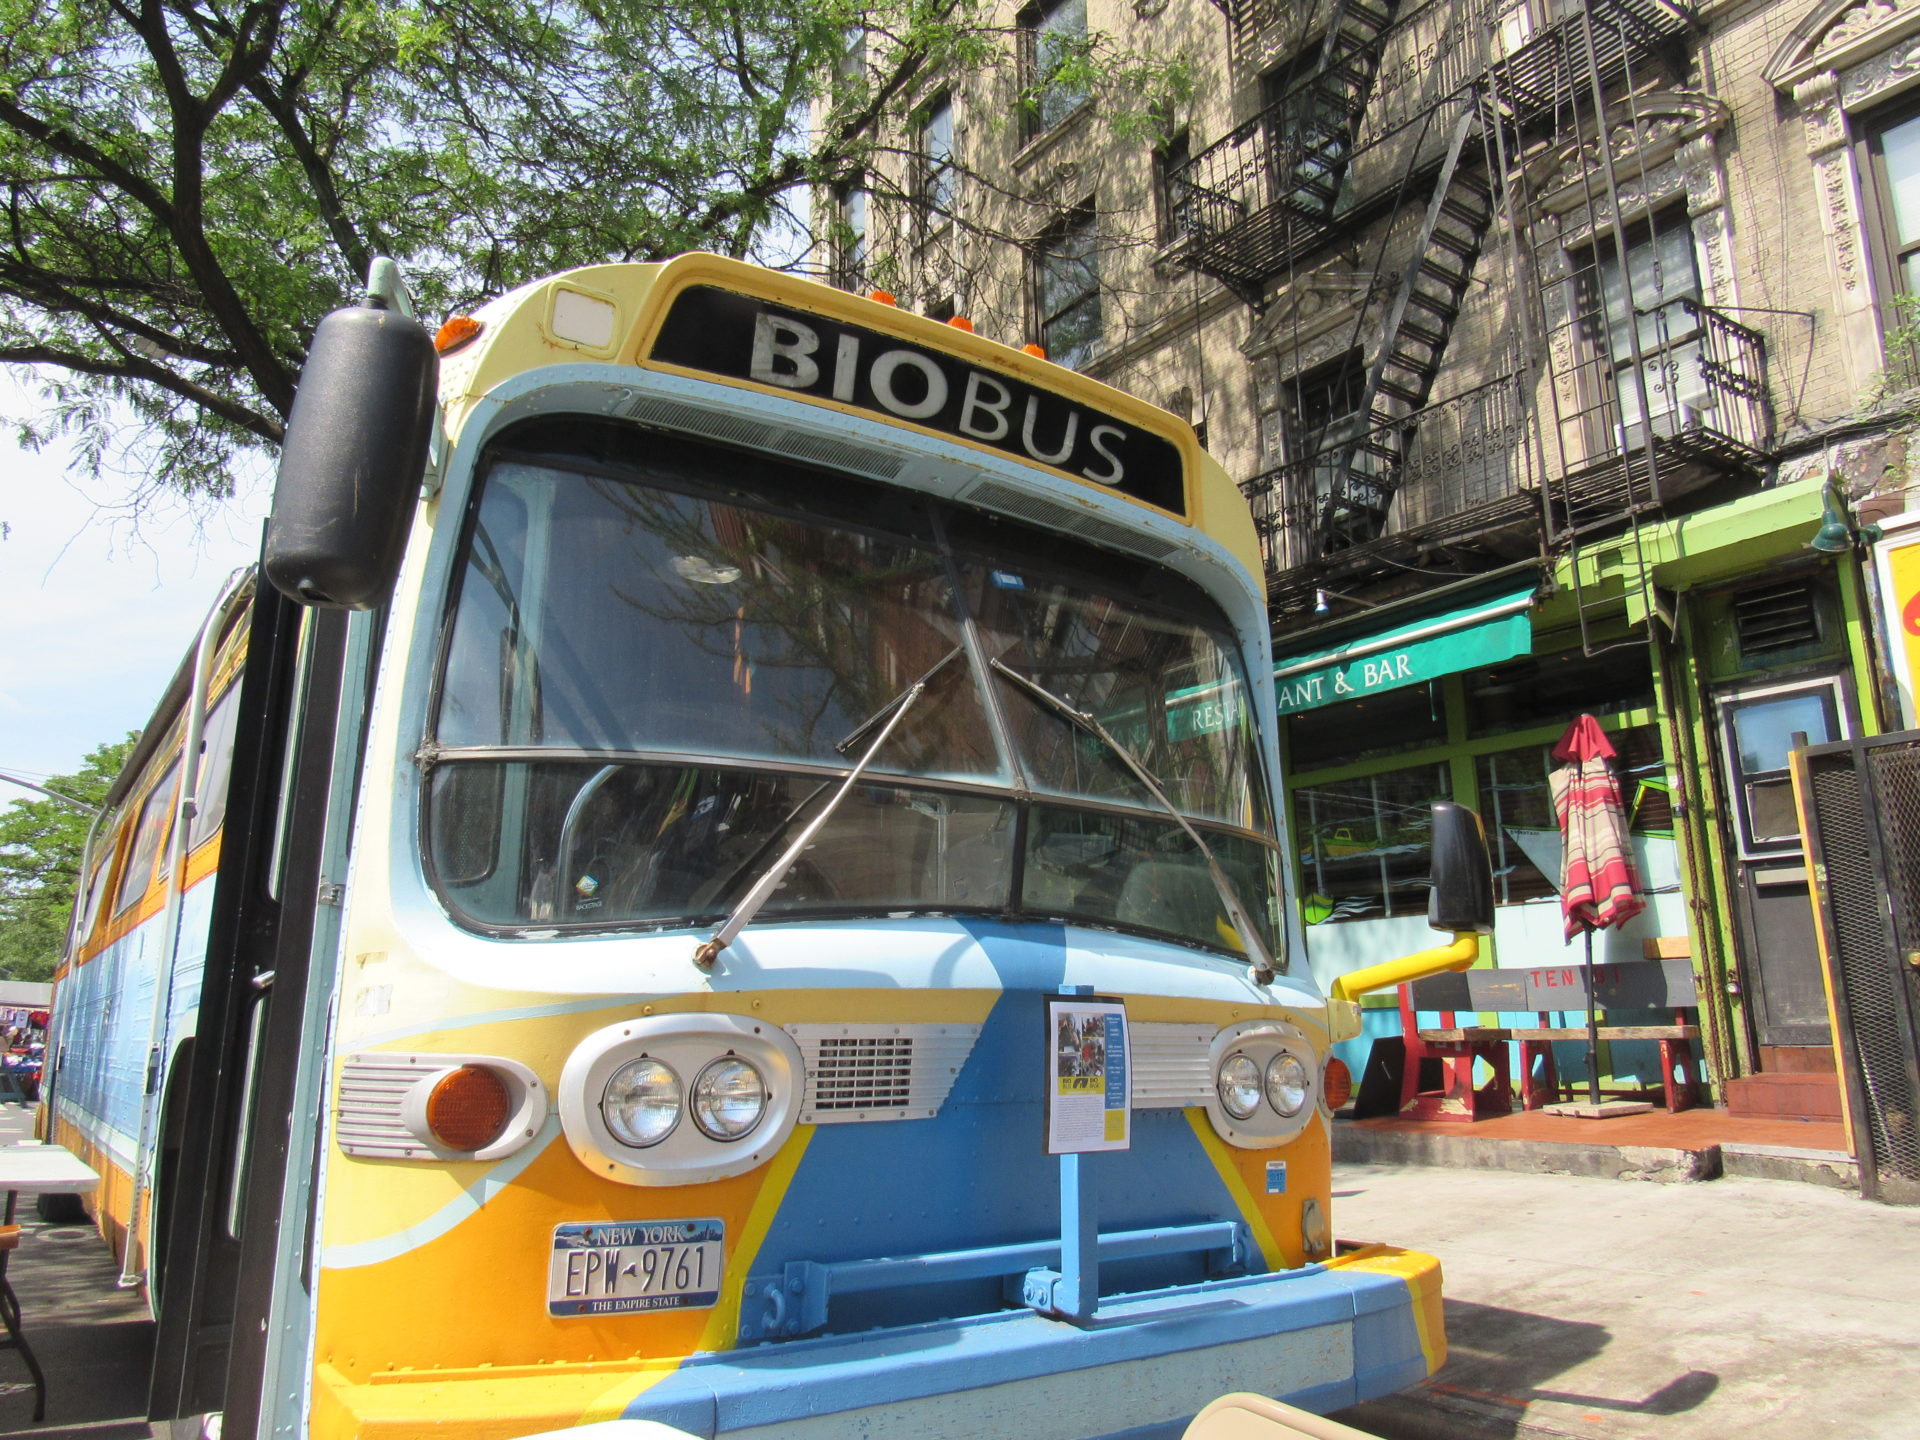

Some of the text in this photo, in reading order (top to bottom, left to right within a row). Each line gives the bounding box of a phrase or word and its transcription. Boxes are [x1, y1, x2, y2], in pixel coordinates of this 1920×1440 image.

[750, 312, 1127, 485] BIOBUS
[1334, 671, 1354, 694] &
[1364, 654, 1413, 687] BAR
[1530, 968, 1575, 987] TEN
[597, 1225, 686, 1246] NEW YORK
[640, 1246, 705, 1292] 9761
[592, 1296, 680, 1311] THE EMPIRE STATE
